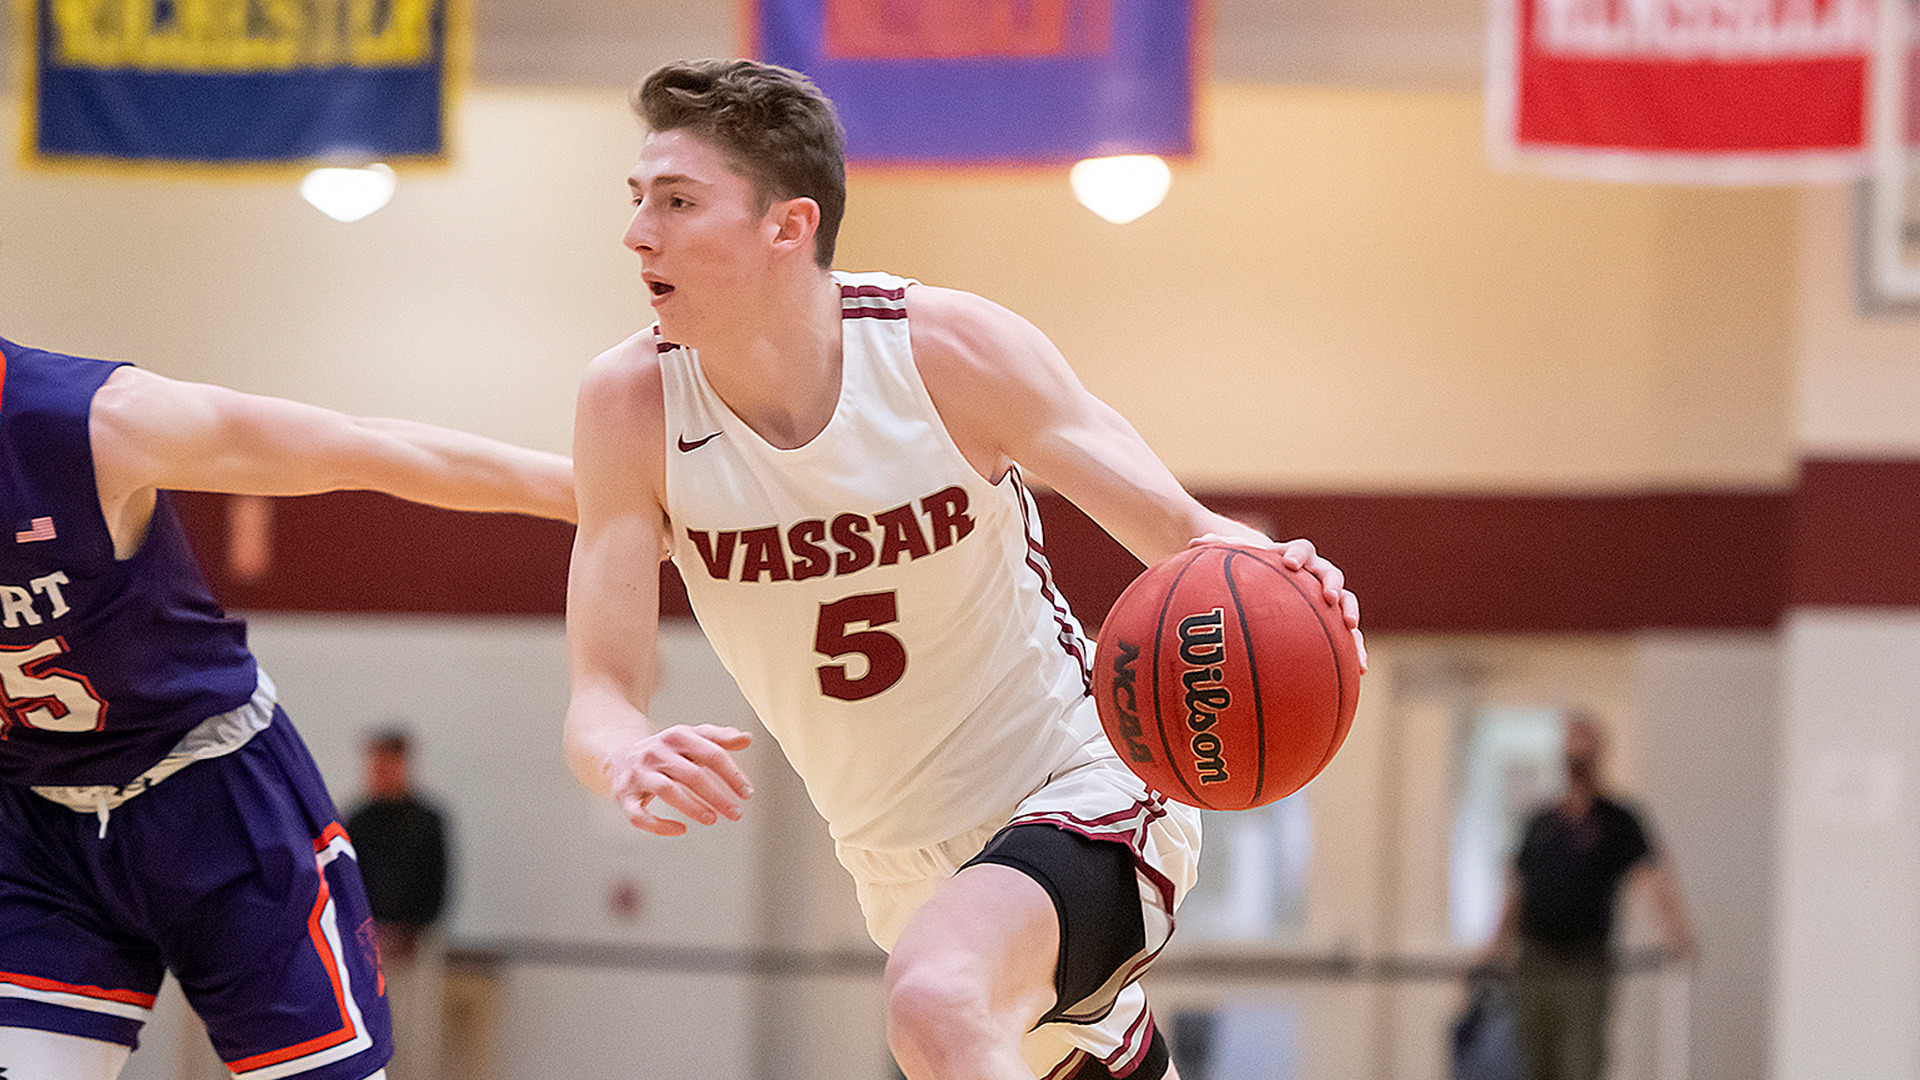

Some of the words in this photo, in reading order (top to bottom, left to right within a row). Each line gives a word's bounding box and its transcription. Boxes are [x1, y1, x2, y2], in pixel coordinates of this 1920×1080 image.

[685, 484, 977, 583] VASSAR
[0, 635, 109, 740] 5
[813, 588, 909, 703] 5
[1113, 636, 1154, 763] NCAA
[1176, 607, 1233, 785] Wilson
